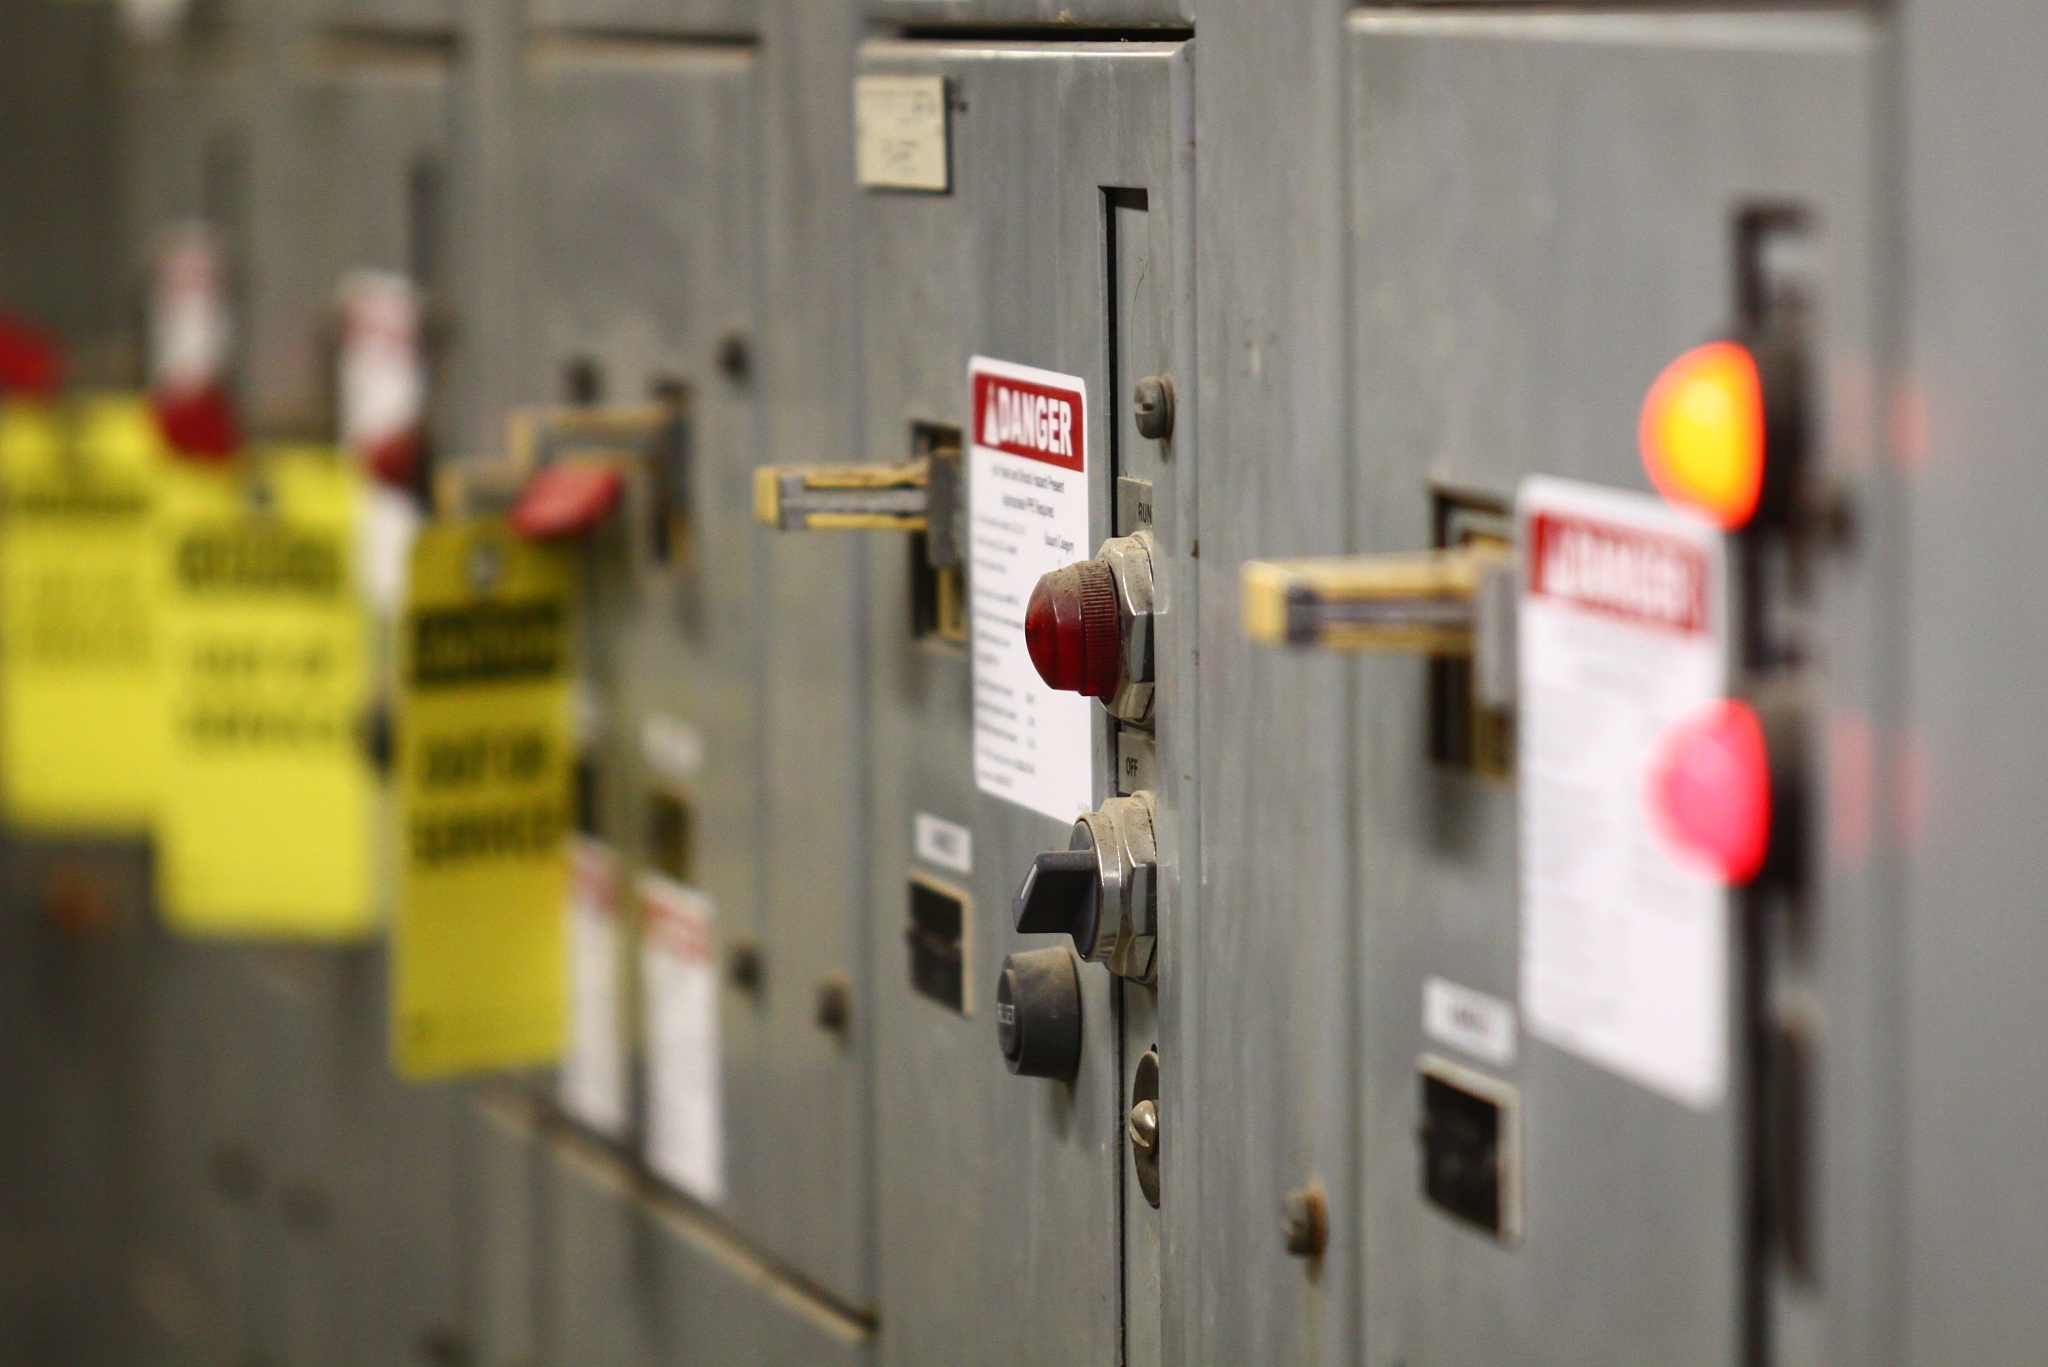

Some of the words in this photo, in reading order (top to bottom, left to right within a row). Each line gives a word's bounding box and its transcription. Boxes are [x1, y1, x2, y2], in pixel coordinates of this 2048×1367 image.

[998, 386, 1073, 457] DANGER
[1138, 502, 1152, 524] RUN
[1126, 757, 1138, 777] OFF
